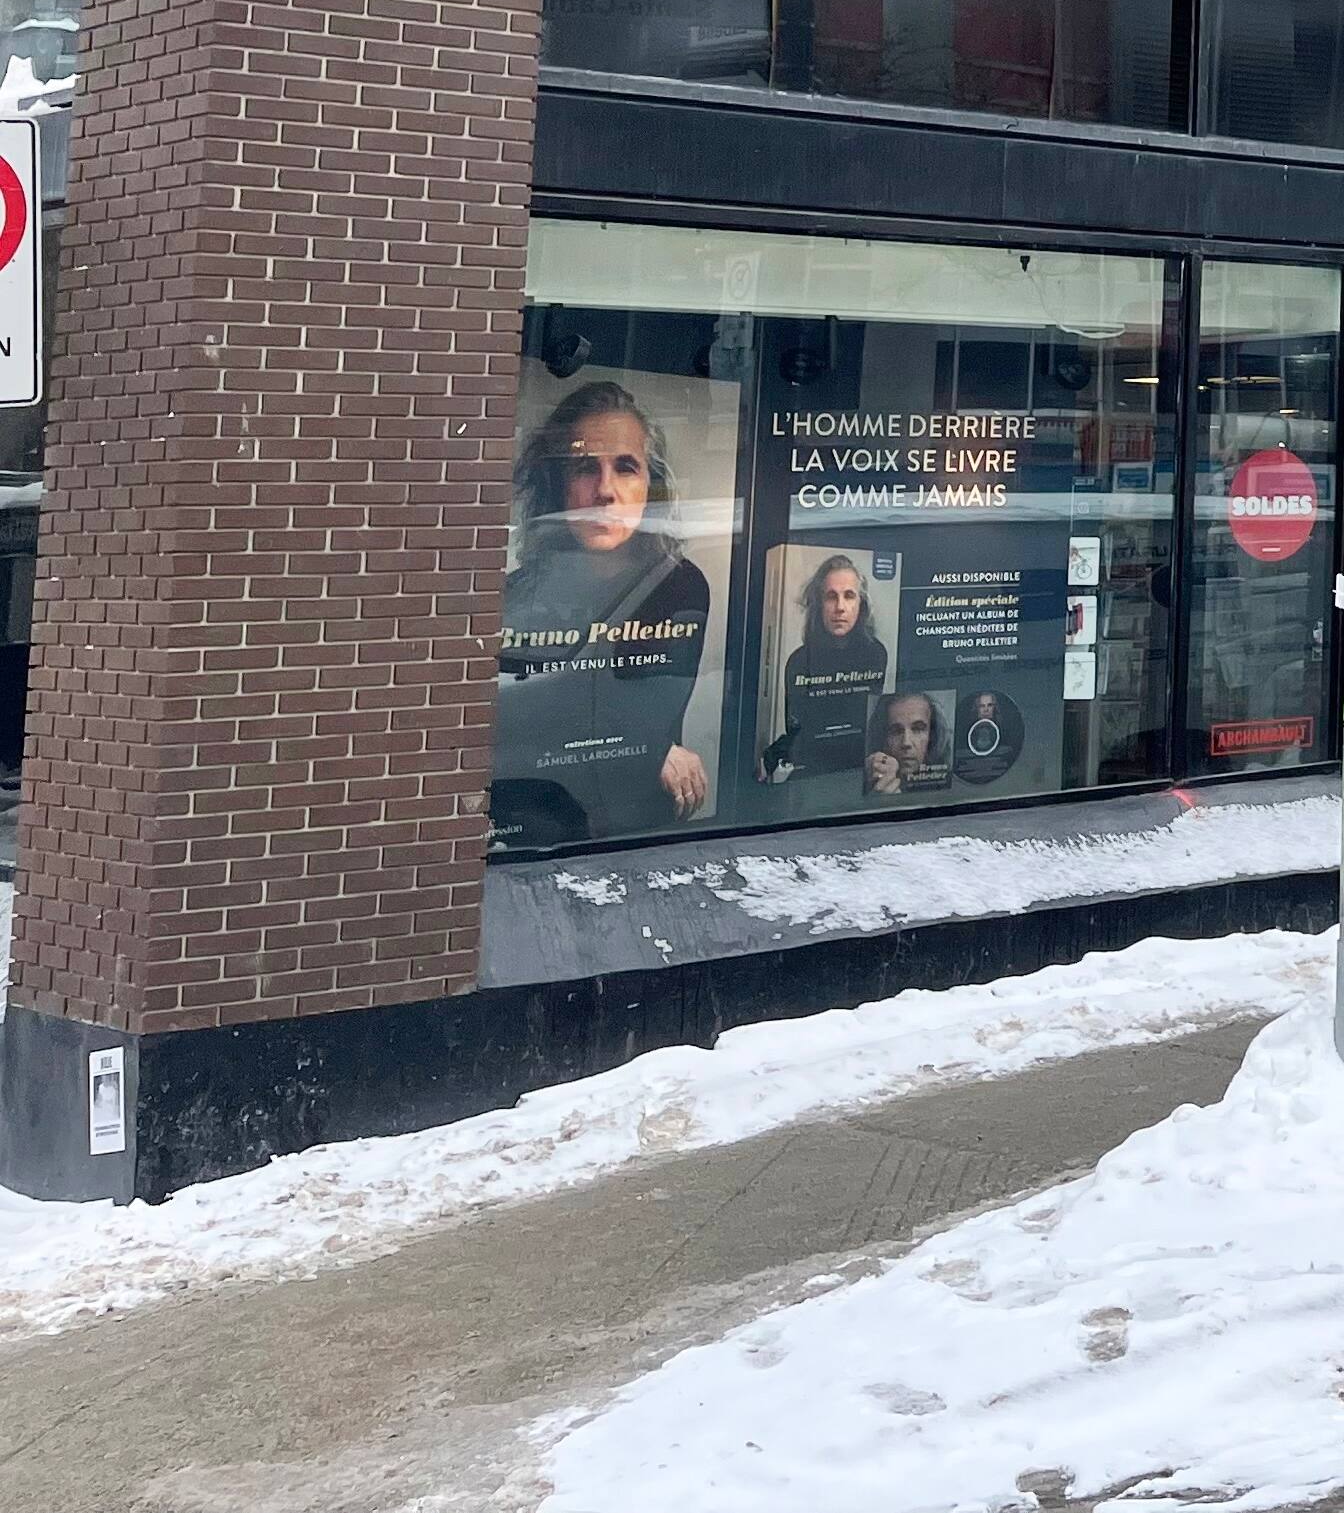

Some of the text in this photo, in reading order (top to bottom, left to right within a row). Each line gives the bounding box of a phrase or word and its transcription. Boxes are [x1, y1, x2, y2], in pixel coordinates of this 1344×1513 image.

[772, 410, 1036, 439] L'HOMME DERRIÈRE
[790, 449, 1017, 473] LA VOIX SE LIVRE
[798, 483, 1007, 509] COMME JAMAIS
[1232, 495, 1313, 516] SOLDES
[932, 571, 1021, 584] AUSSI DISPONIBLE
[916, 609, 1019, 622] INCLUANT UN ALBUM DE
[500, 618, 698, 648] Bruno Pelletier
[915, 624, 965, 636] CHANSONS
[1007, 623, 1018, 632] DE
[942, 636, 1018, 648] BRUNO PELLETIER
[525, 664, 537, 674] IL
[542, 661, 566, 673] EST
[571, 658, 606, 671] VENU
[610, 656, 625, 668] LE
[794, 669, 884, 686] Bruno Pelletier
[1217, 725, 1307, 748] ARCHAMBAULT
[536, 745, 648, 768] SAMUEL LAROCHELLE
